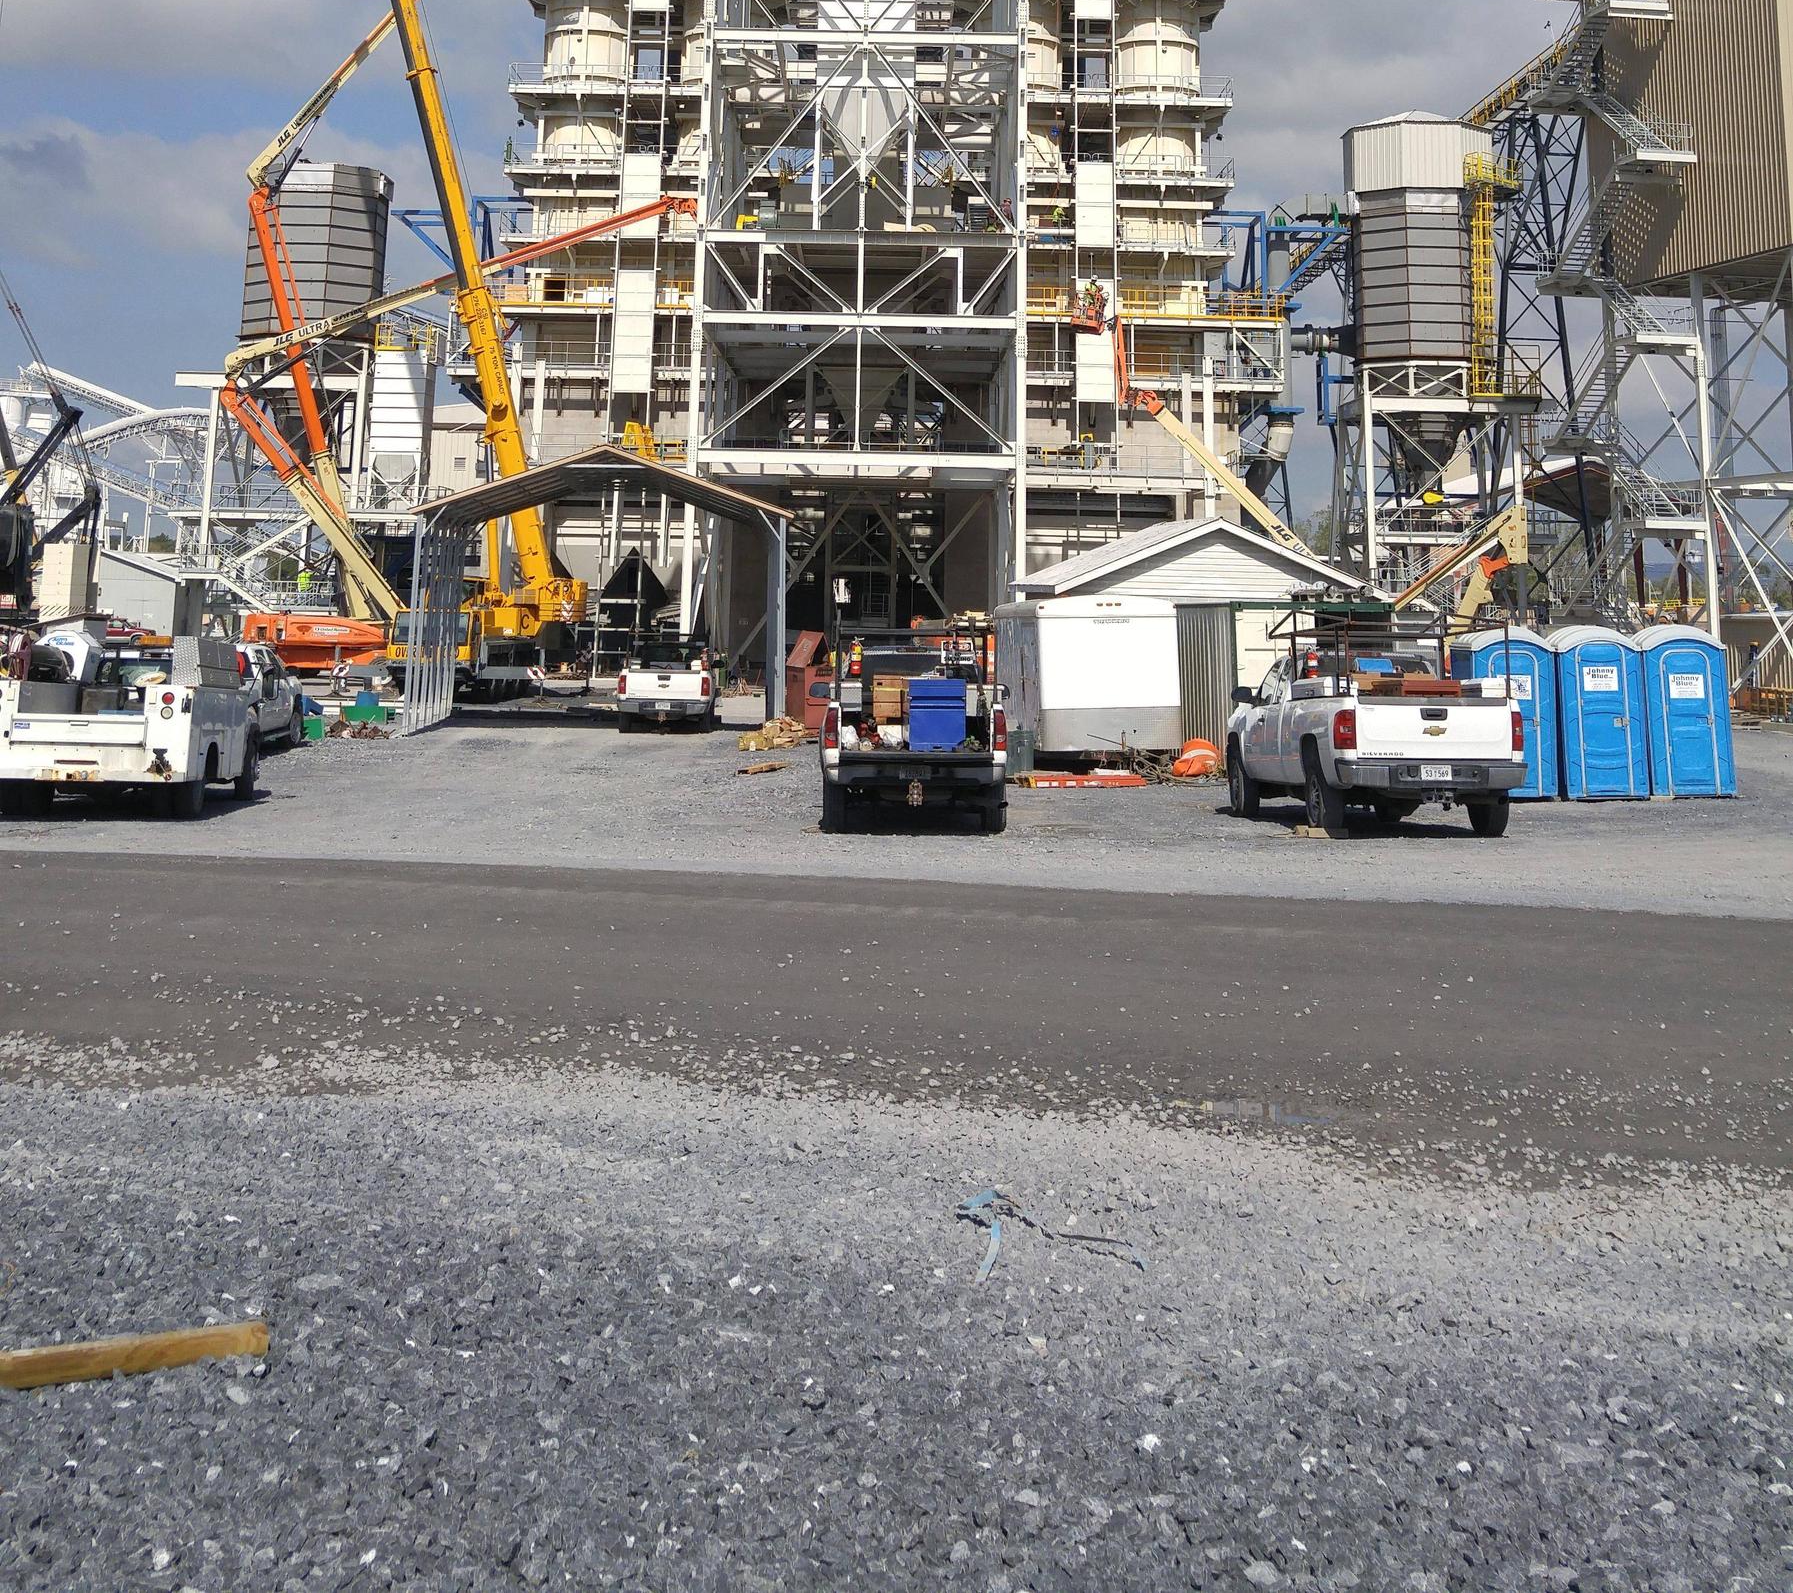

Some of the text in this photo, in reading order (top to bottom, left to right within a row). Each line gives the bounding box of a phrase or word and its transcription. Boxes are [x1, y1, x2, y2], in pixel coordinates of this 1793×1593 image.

[277, 129, 292, 148] JLG
[273, 319, 330, 347] JLG ULTRA
[1270, 524, 1294, 542] JLG
[1586, 667, 1614, 676] Johnny
[1671, 675, 1700, 683] Johnny
